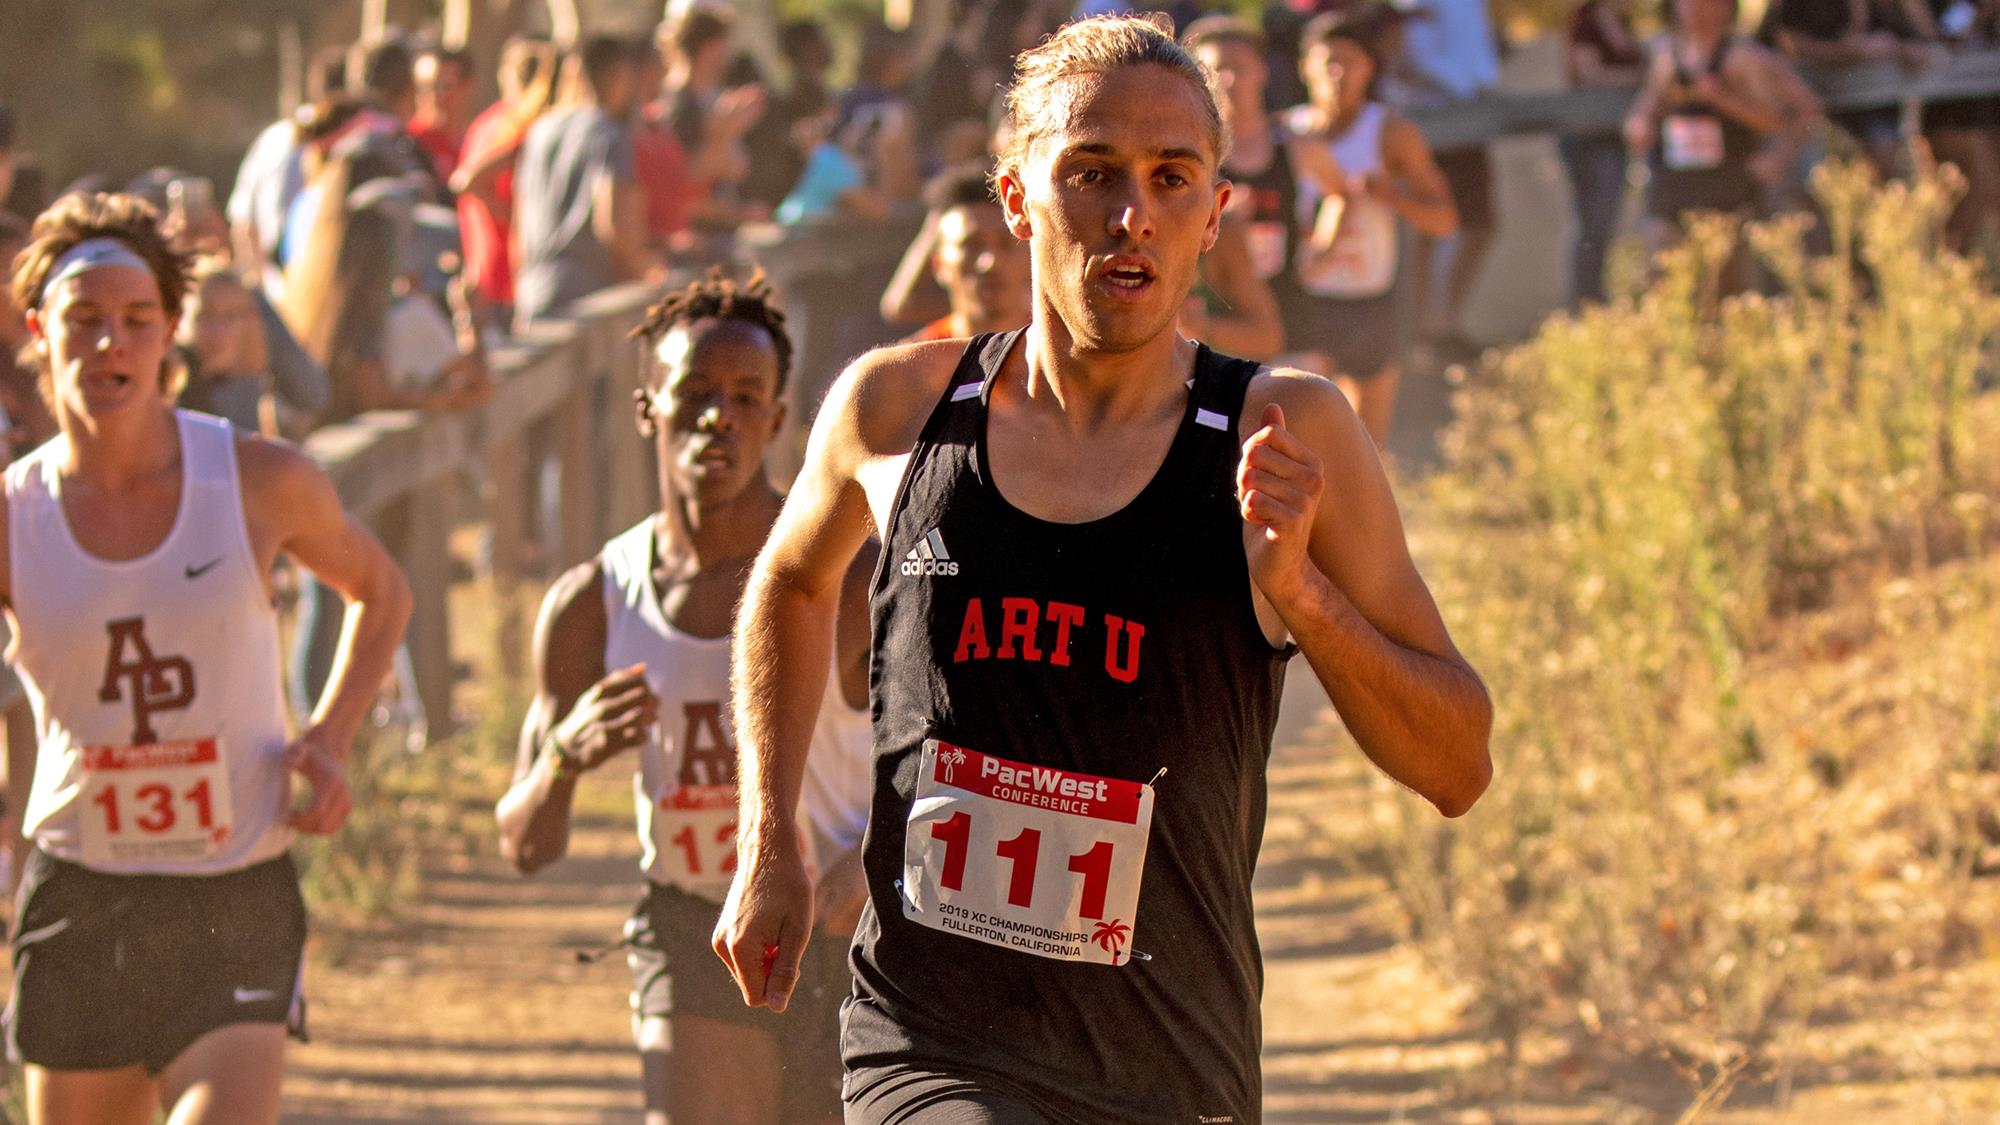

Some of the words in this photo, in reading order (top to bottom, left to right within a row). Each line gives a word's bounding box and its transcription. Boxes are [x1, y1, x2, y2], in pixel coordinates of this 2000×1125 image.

[901, 559, 959, 576] adidas
[953, 597, 1085, 667] ART
[1104, 613, 1145, 683] U
[981, 756, 1108, 802] PacWest
[992, 785, 1089, 814] CONFERENCE
[93, 777, 213, 834] 131
[931, 811, 1114, 920] 111
[939, 903, 969, 919] 2019
[971, 911, 987, 924] XC
[989, 916, 1089, 943] CHAMPIONSHIPS
[942, 917, 1008, 944] FULLERTON,
[1011, 935, 1081, 957] CALIFORNIA
